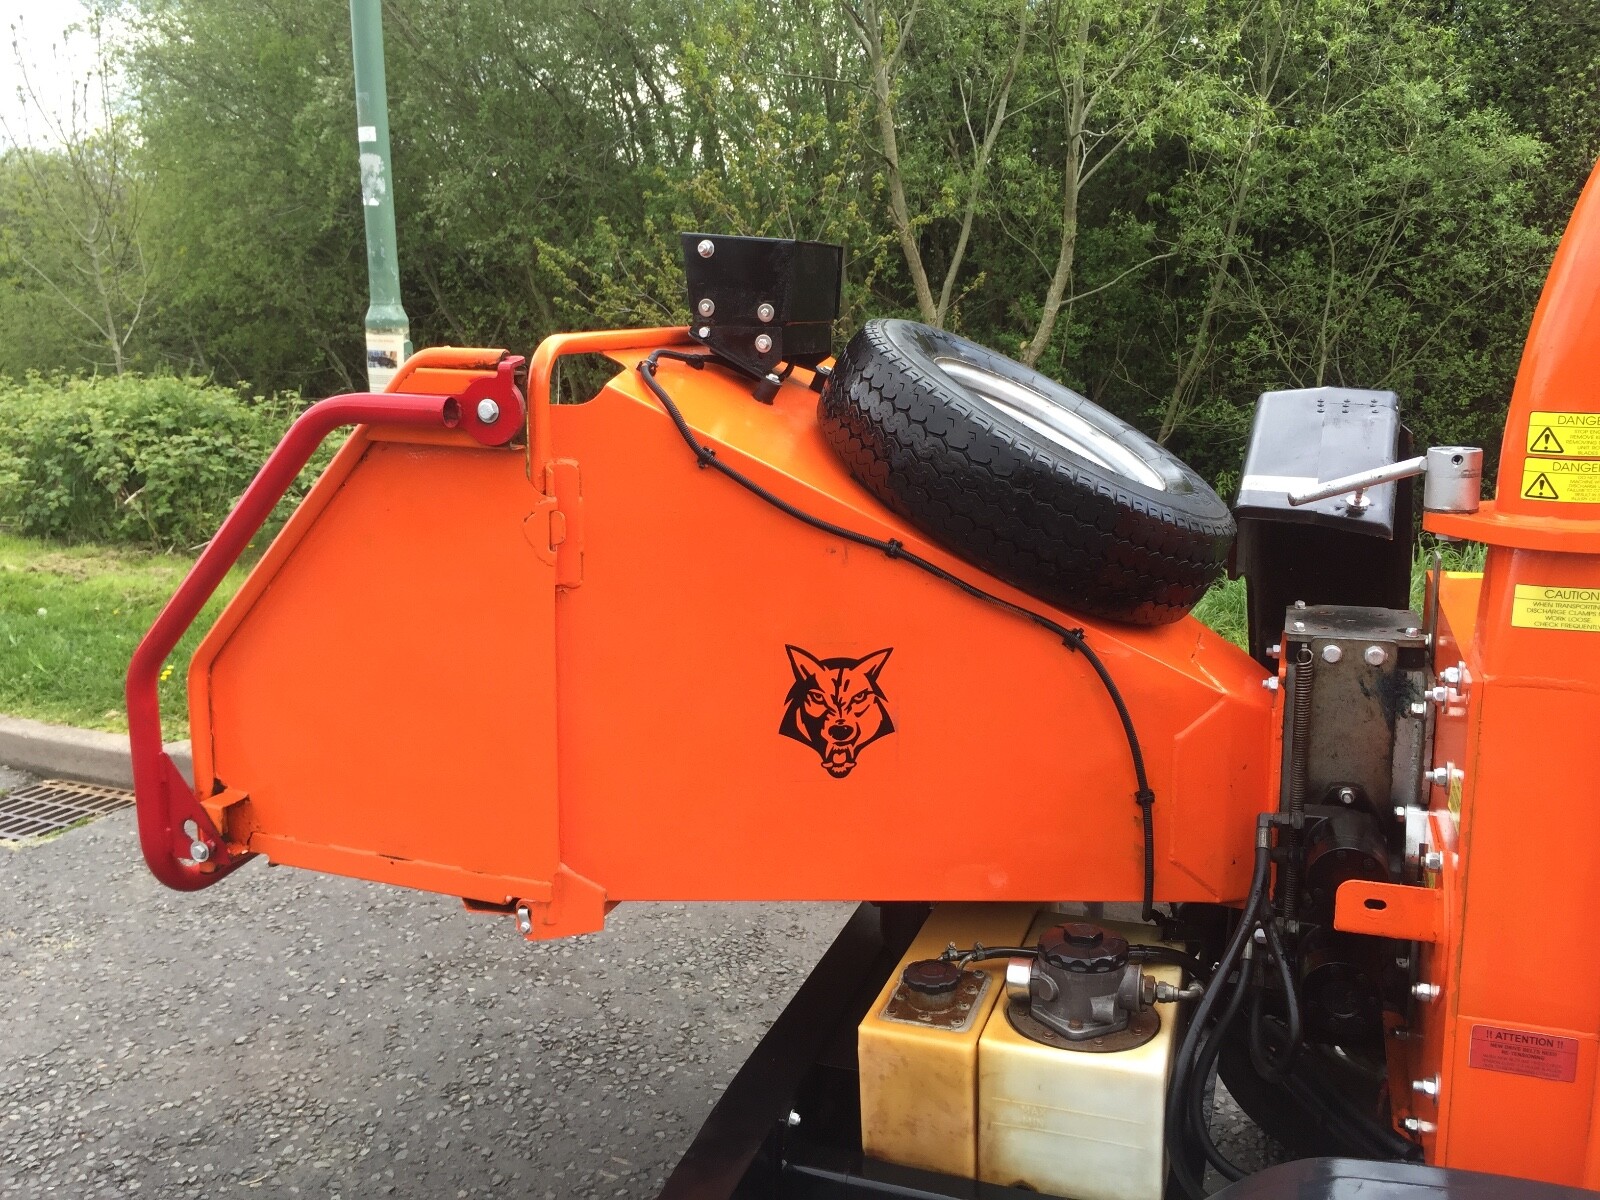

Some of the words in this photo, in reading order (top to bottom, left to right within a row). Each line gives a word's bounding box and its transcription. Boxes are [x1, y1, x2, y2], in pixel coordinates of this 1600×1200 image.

[1552, 461, 1600, 473] DANGE
[1544, 589, 1600, 601] CAUTION
[1526, 607, 1567, 616] DISCHARGE
[1568, 609, 1597, 617] CLAMPS
[1495, 1031, 1554, 1048] ATTENTION
[1504, 1044, 1521, 1052] DRIVE
